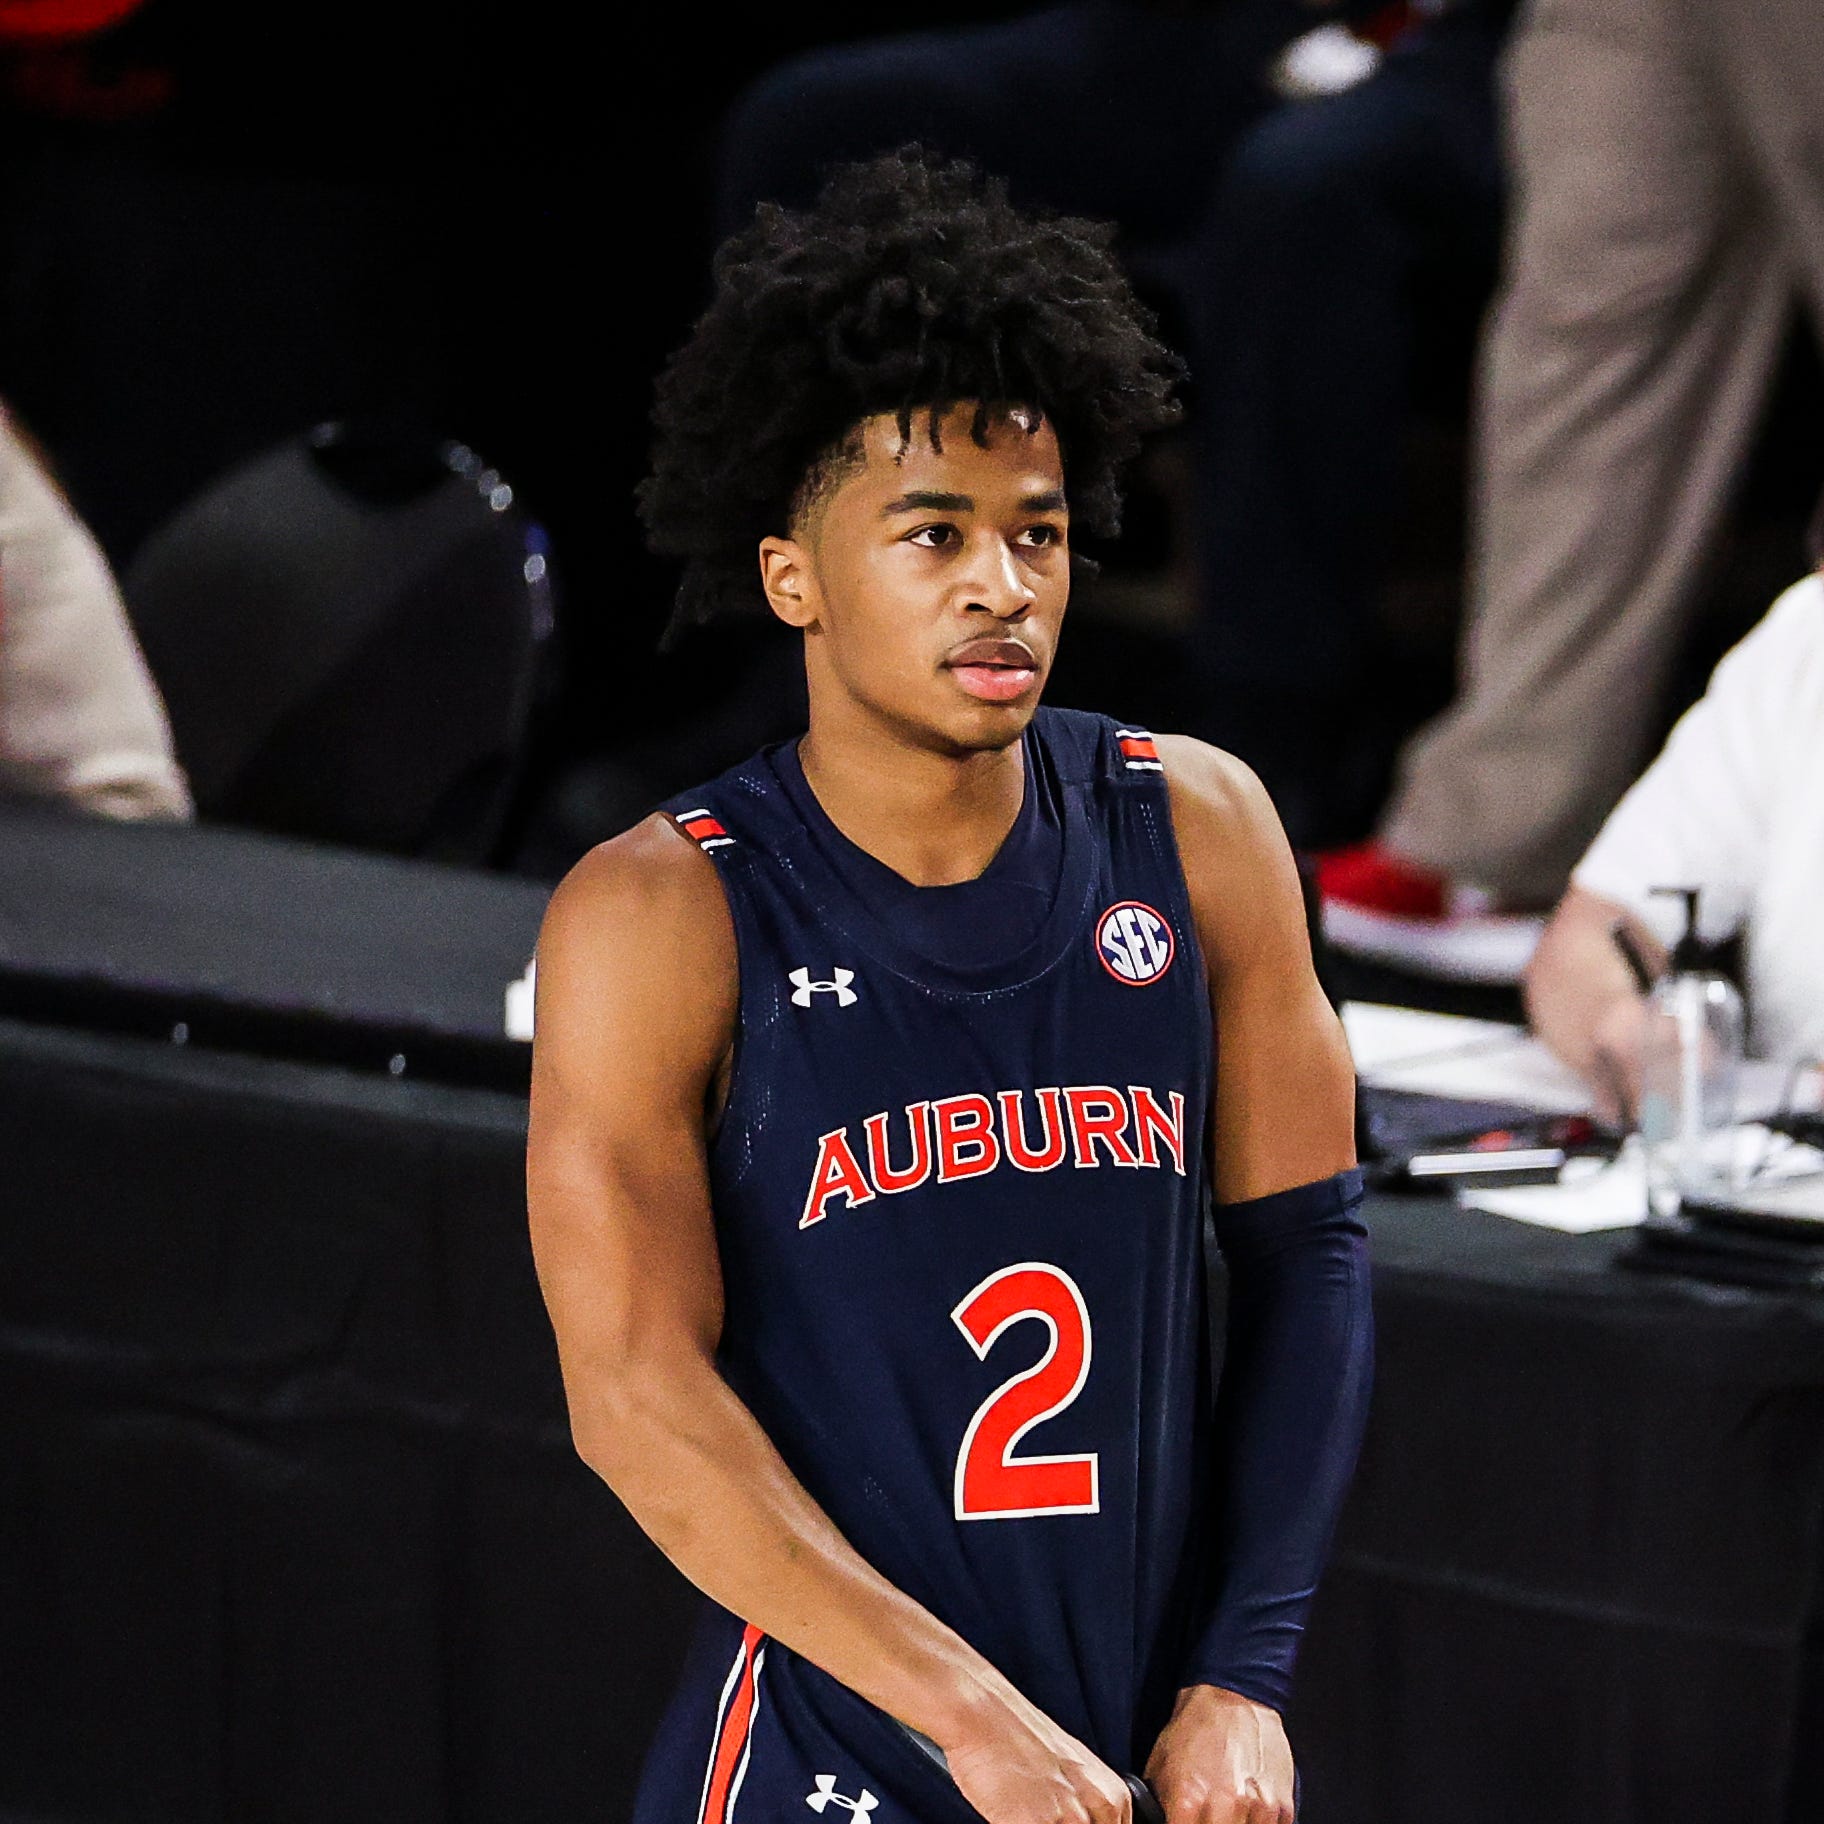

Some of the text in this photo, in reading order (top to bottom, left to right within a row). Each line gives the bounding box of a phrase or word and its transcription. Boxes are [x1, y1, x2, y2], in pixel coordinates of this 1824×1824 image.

[1101, 907, 1168, 980] SEC
[799, 1085, 1186, 1229] AUBURN
[950, 1262, 1100, 1520] 2
